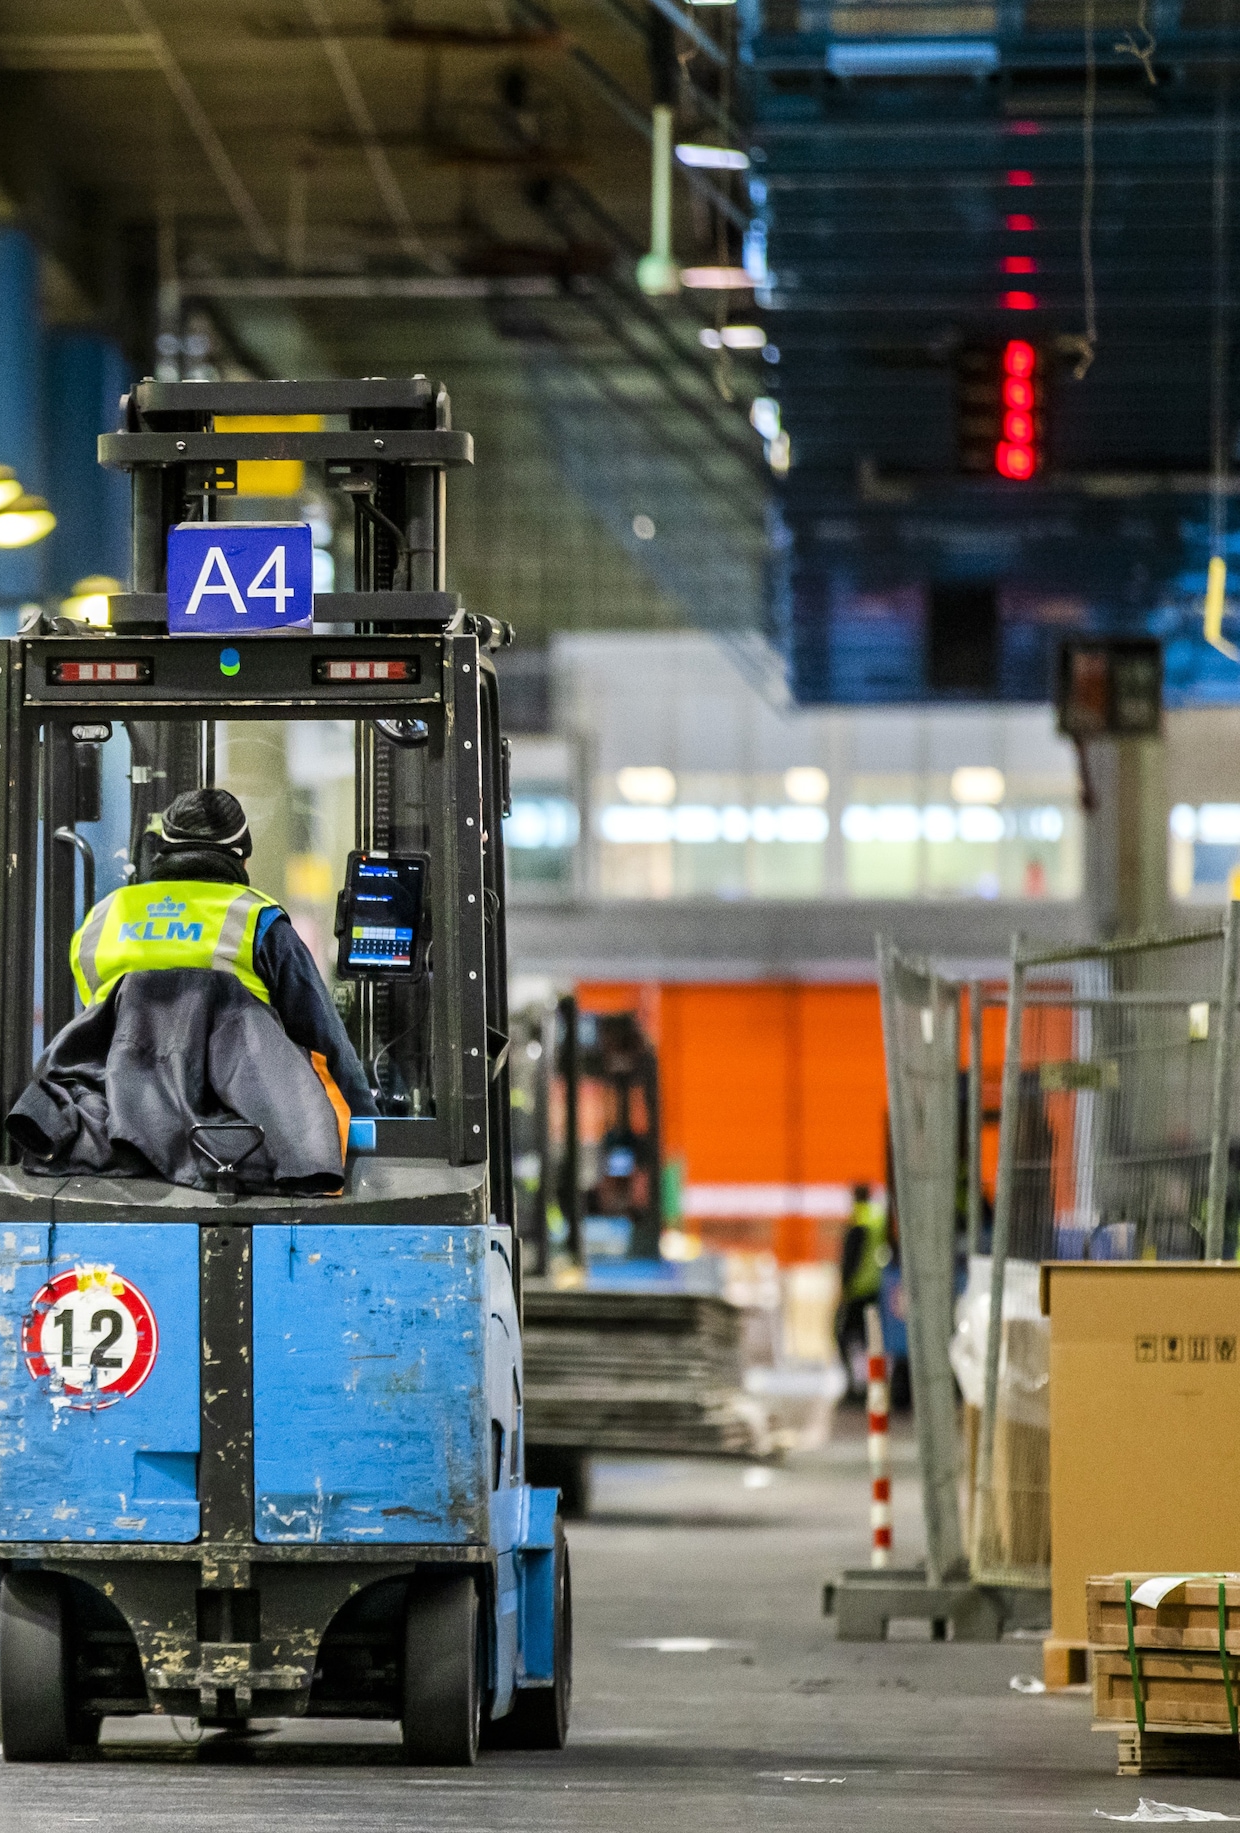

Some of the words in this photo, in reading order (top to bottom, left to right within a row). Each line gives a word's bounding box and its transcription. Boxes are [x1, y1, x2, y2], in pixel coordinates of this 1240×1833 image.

[184, 545, 295, 614] A4
[118, 921, 204, 942] KLM
[53, 1308, 123, 1369] 12
